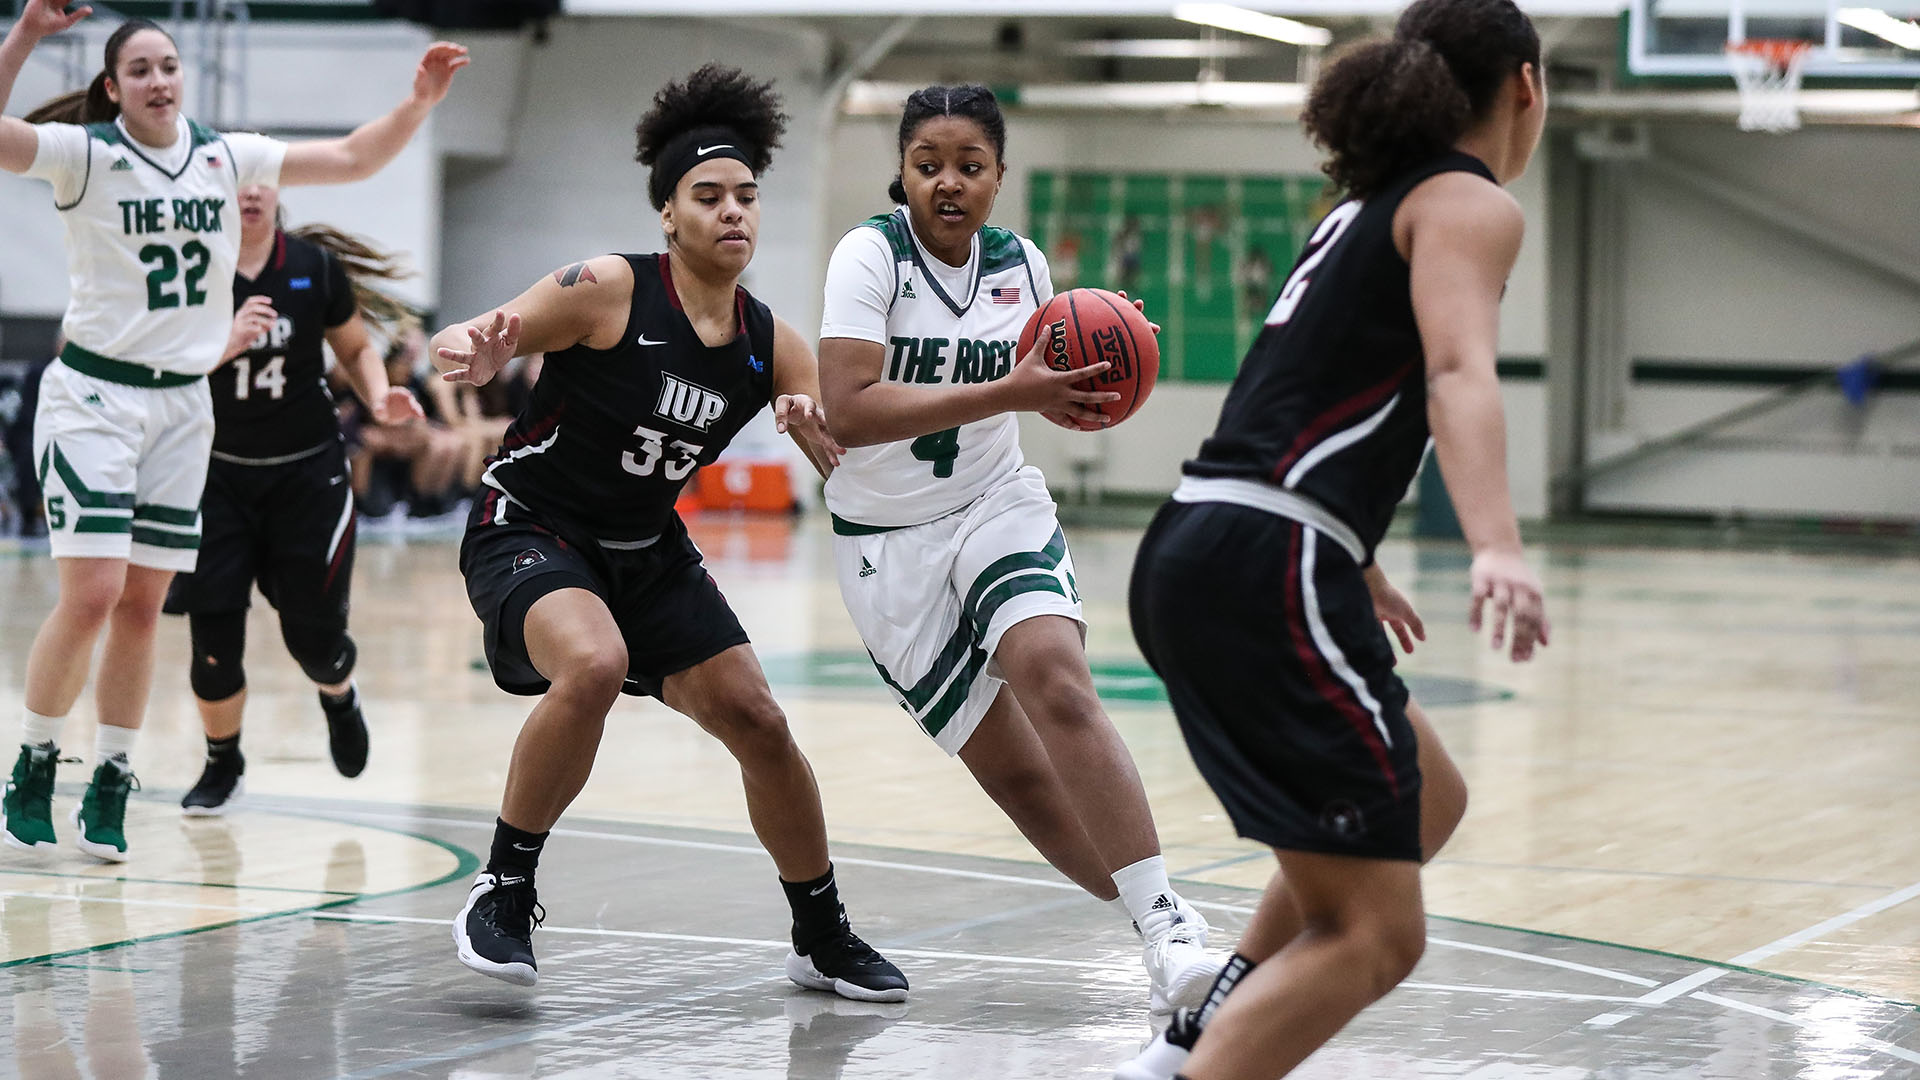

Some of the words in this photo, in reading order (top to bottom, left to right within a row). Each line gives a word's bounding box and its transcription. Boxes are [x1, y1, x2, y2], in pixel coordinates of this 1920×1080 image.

[118, 199, 165, 235] THE
[172, 199, 225, 232] ROCK
[139, 240, 211, 311] 22
[1264, 200, 1363, 326] 2
[233, 356, 287, 400] 14
[888, 336, 949, 384] THE
[951, 338, 1017, 384] ROCK
[1098, 325, 1125, 385] PSAC
[656, 373, 727, 431] IUP
[621, 425, 703, 481] 33
